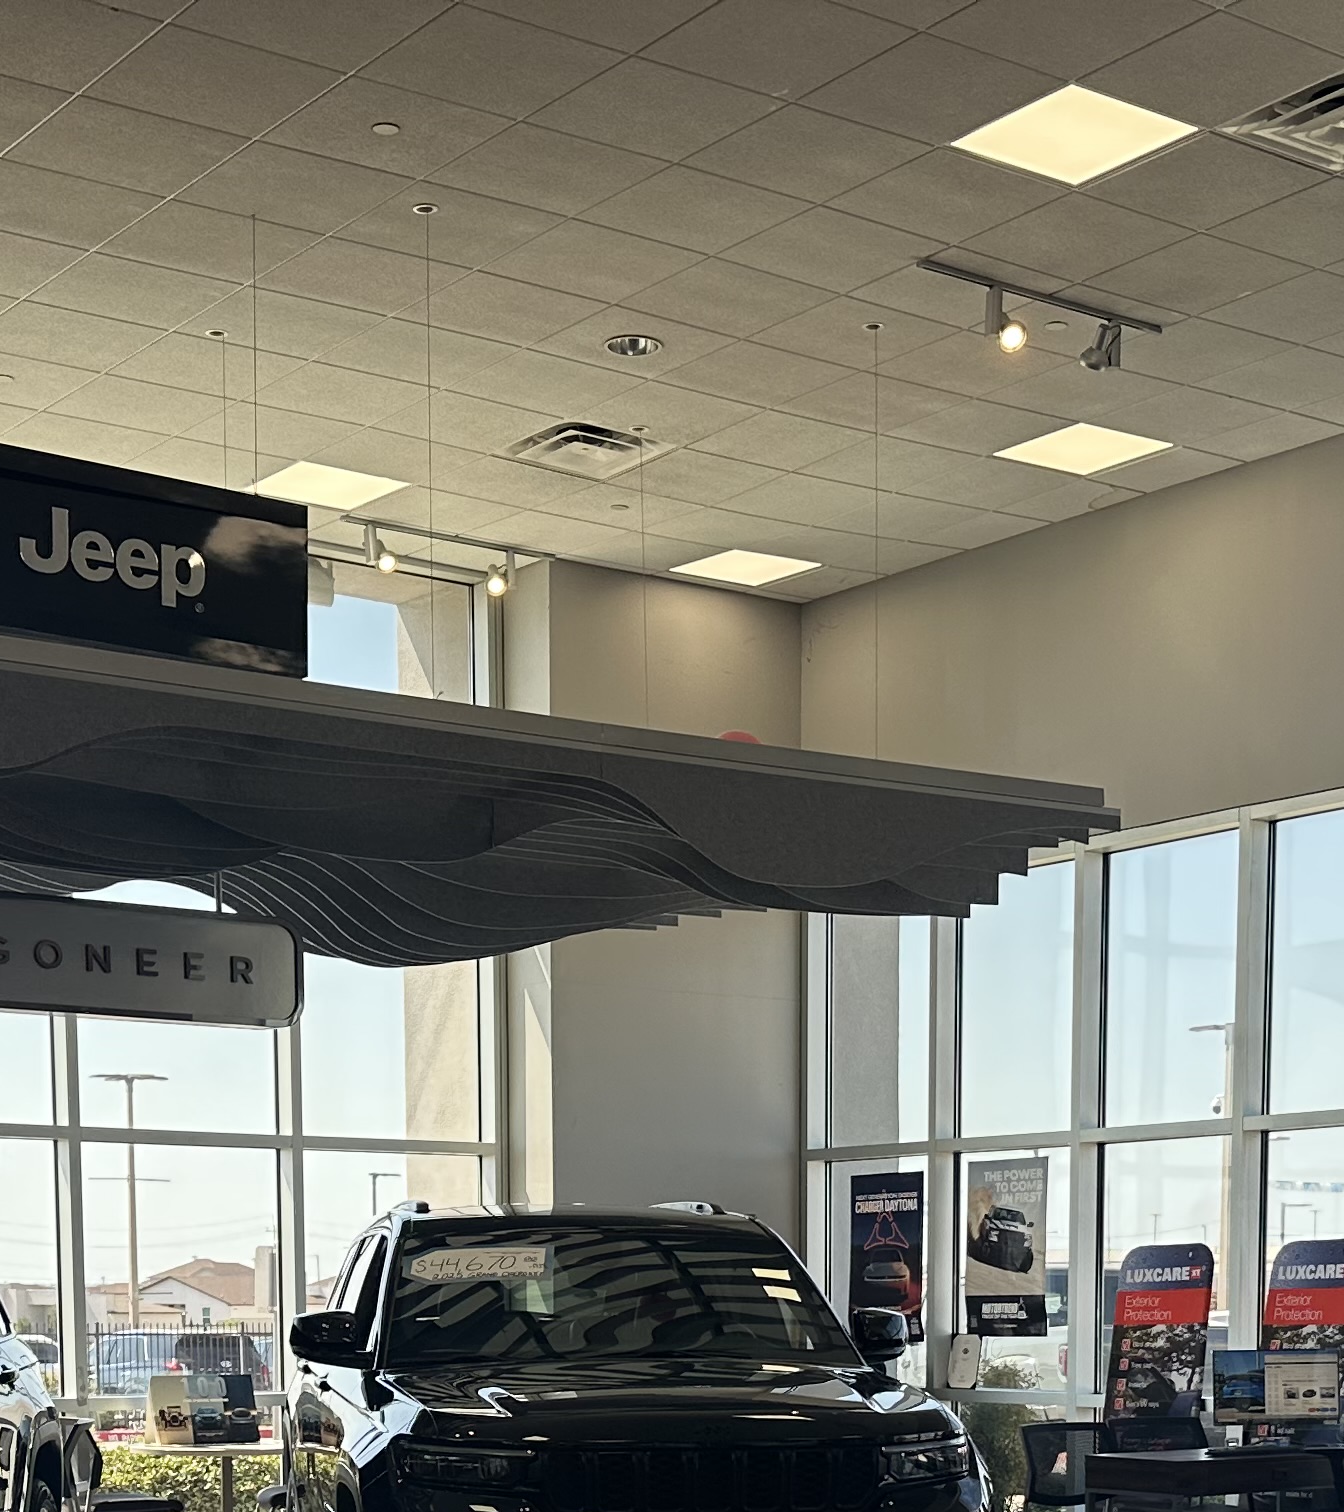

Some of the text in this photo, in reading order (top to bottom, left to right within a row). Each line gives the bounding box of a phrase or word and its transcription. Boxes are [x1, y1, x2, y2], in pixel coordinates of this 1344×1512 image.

[19, 506, 206, 608] Jeep
[984, 1169, 1044, 1182] THE POWER
[995, 1179, 1044, 1193] TO COME
[885, 1198, 918, 1211] DAYTONA
[1001, 1191, 1044, 1204] IN FIRST
[415, 1255, 517, 1274] $44,670
[1125, 1266, 1190, 1283] LUXCARE
[1278, 1264, 1344, 1280] LUXCARE
[1125, 1295, 1161, 1308] Exterior
[1275, 1293, 1312, 1307] Exterior
[1123, 1308, 1172, 1321] Protection
[1273, 1307, 1323, 1321] Protection
